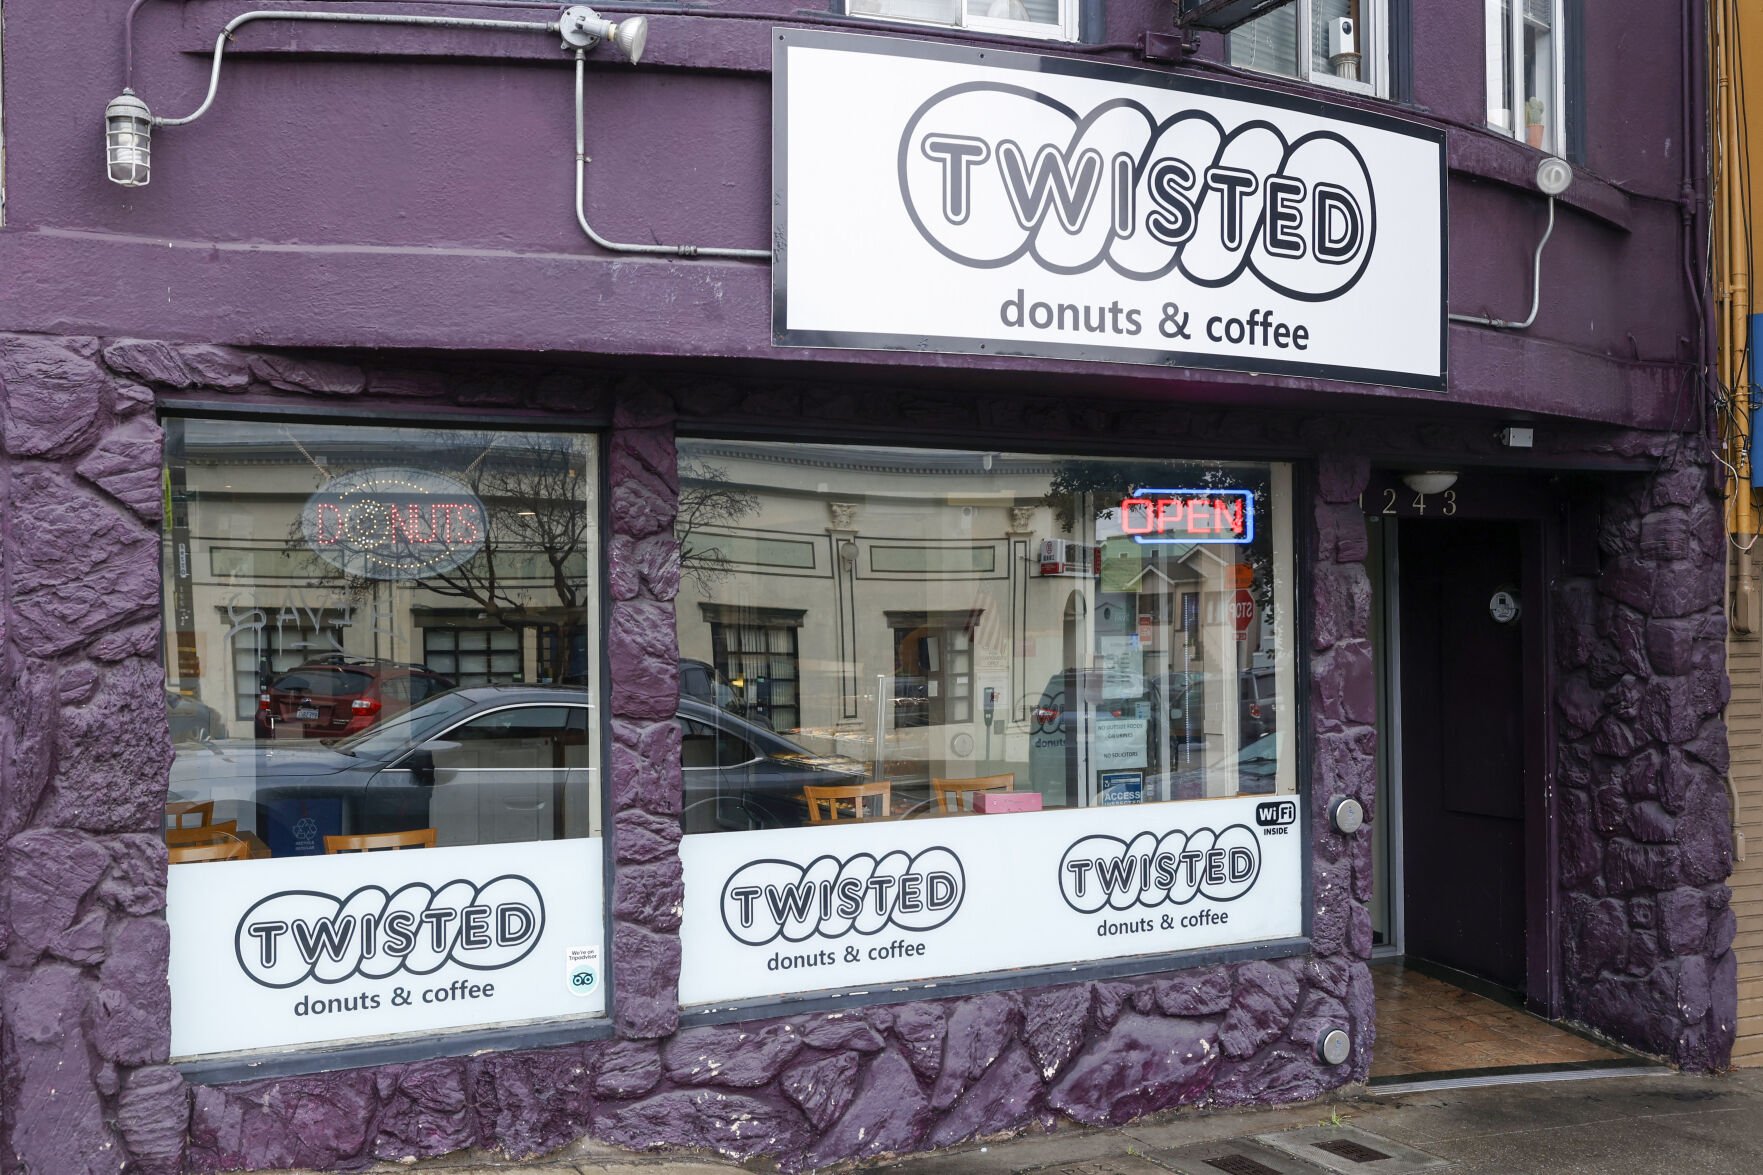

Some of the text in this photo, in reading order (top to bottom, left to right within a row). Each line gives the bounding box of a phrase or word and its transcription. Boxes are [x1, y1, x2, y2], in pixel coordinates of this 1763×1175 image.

[920, 132, 1364, 265] TWISTED
[1000, 288, 1310, 351] donuts & coffee
[318, 499, 477, 548] DONUTS
[1121, 498, 1244, 534] OPEN
[1104, 791, 1141, 801] ACCESS
[1258, 805, 1293, 822] WiFi
[1264, 827, 1289, 836] INSIDE
[1066, 847, 1255, 898] TWISTED
[730, 871, 958, 929] TWISTED
[248, 902, 536, 969] TWISTED
[1096, 909, 1229, 938] donuts & coffee
[766, 939, 926, 973] donuts & coffee
[293, 980, 495, 1017] donuts & coffee
